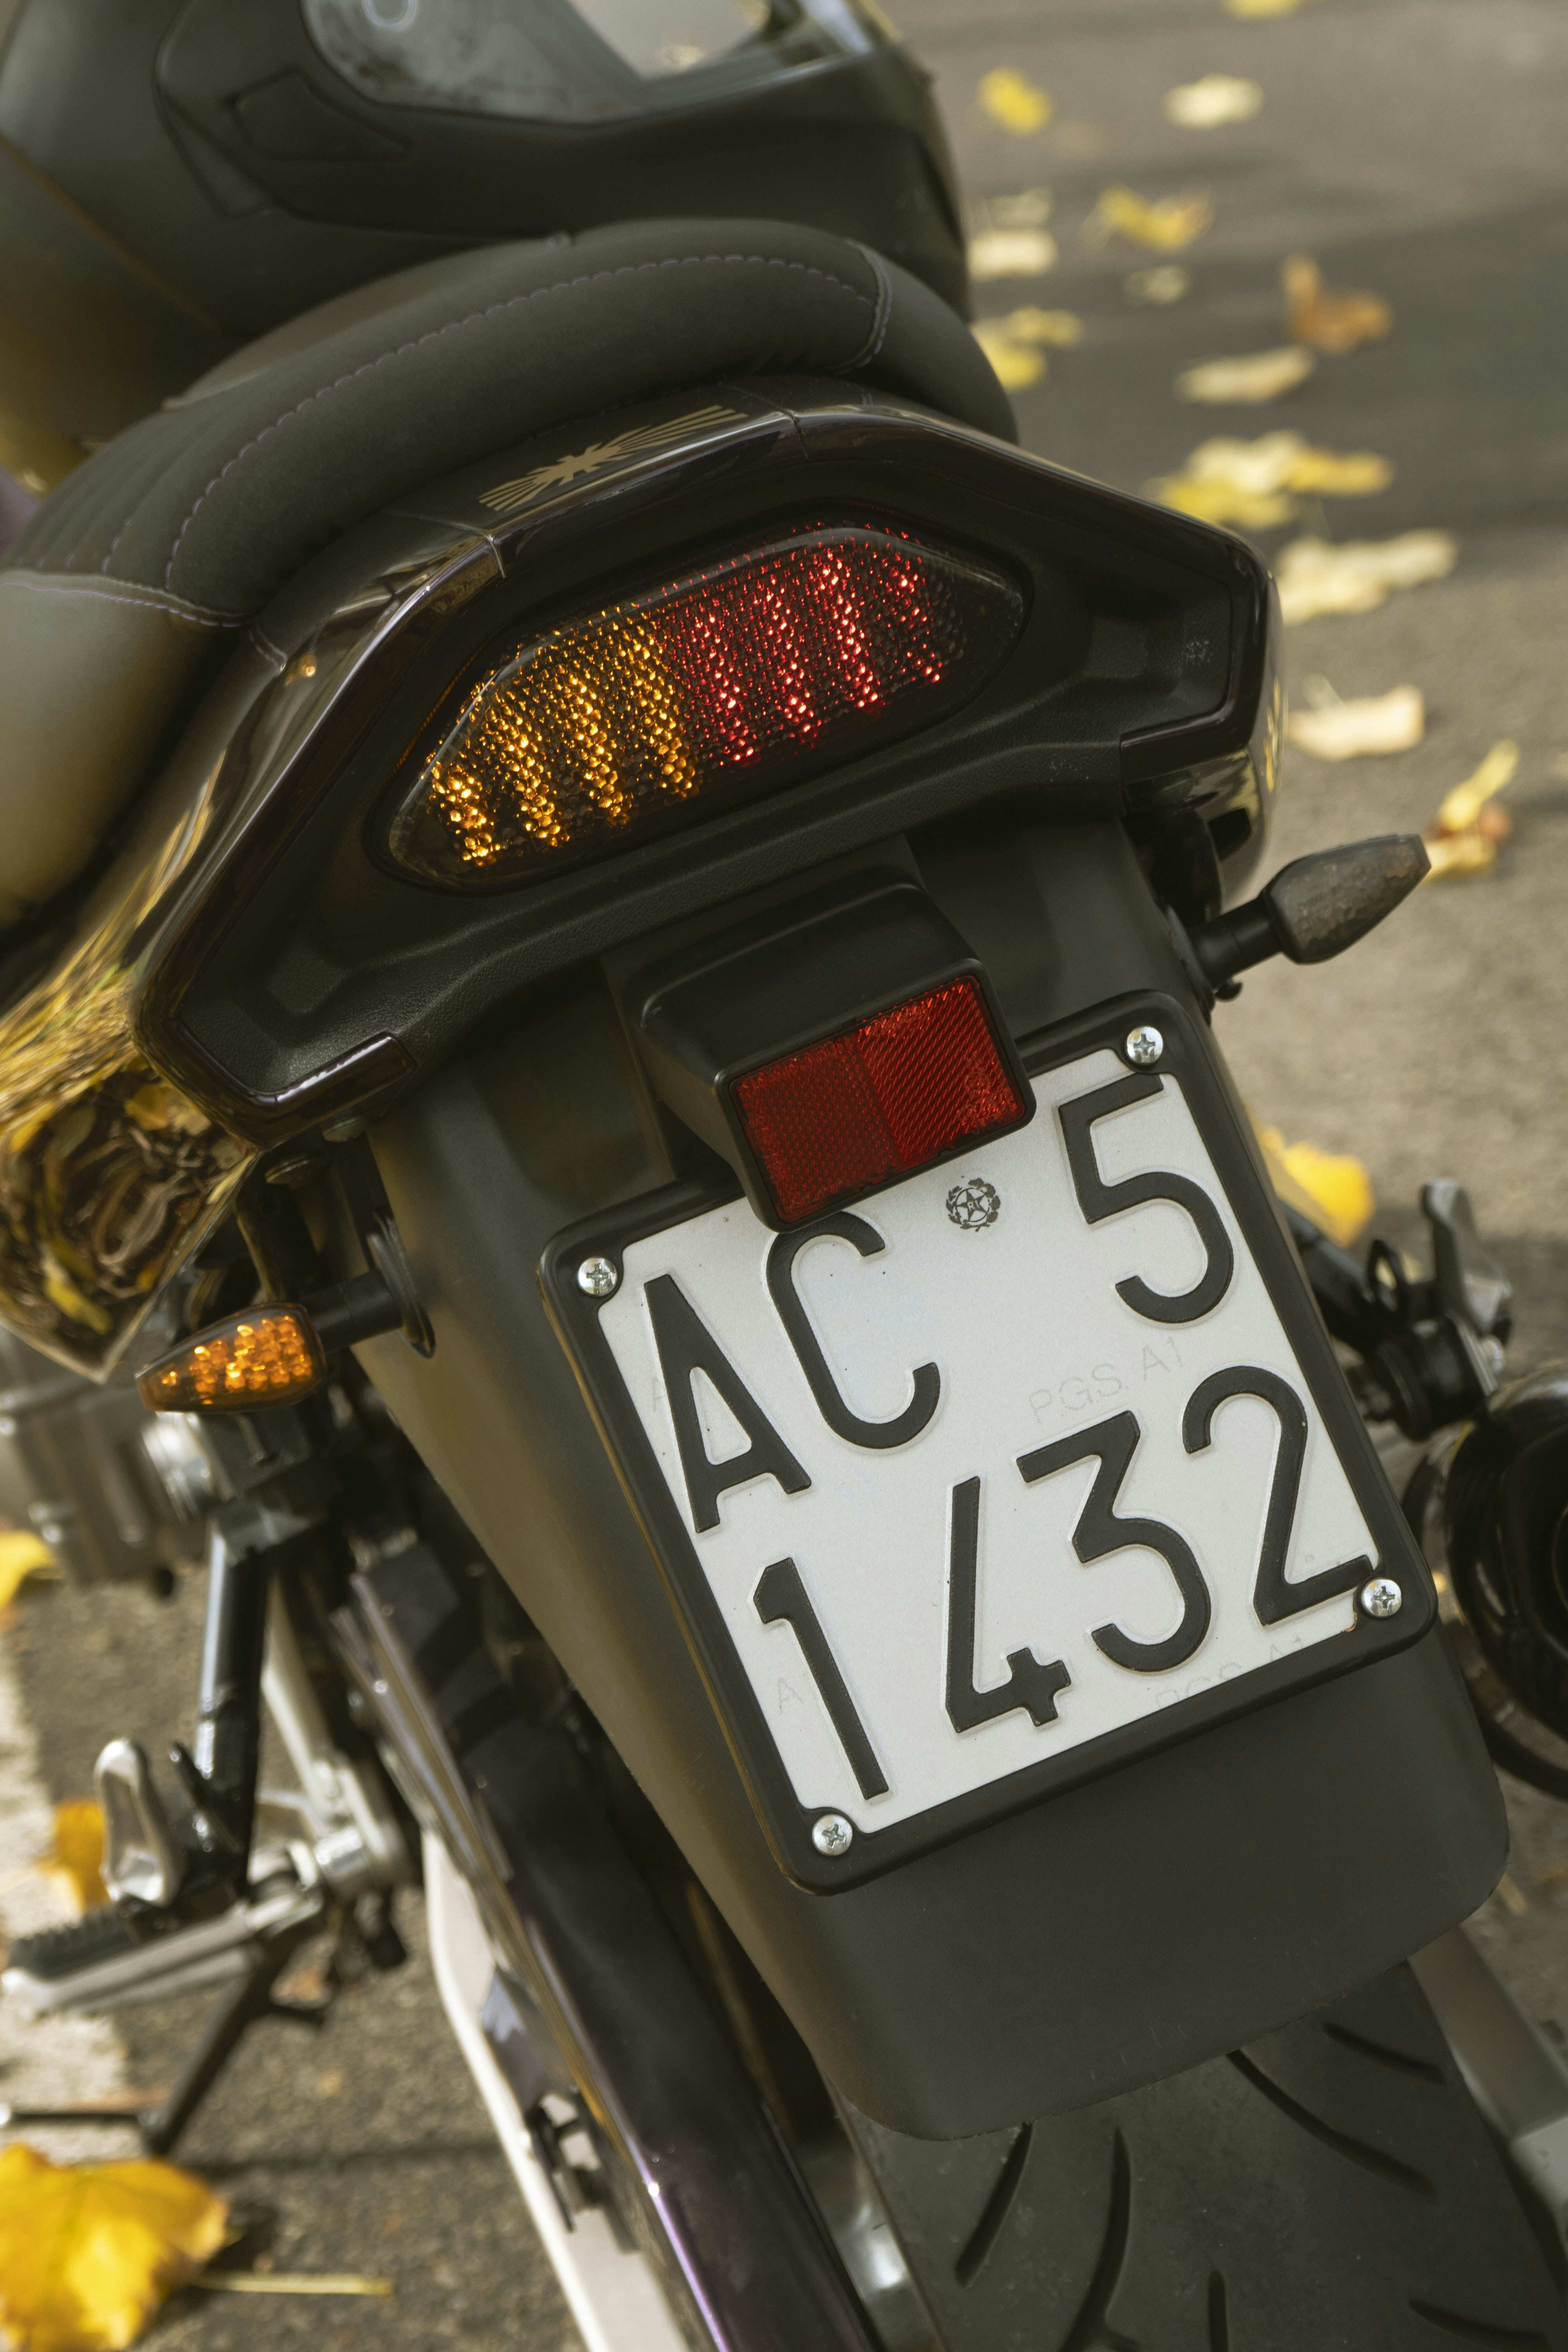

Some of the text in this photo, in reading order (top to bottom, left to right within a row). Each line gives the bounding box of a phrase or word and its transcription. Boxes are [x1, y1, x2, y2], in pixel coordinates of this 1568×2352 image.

[643, 1073, 1236, 1534] AC 5
[753, 1366, 1371, 1800] 1432
